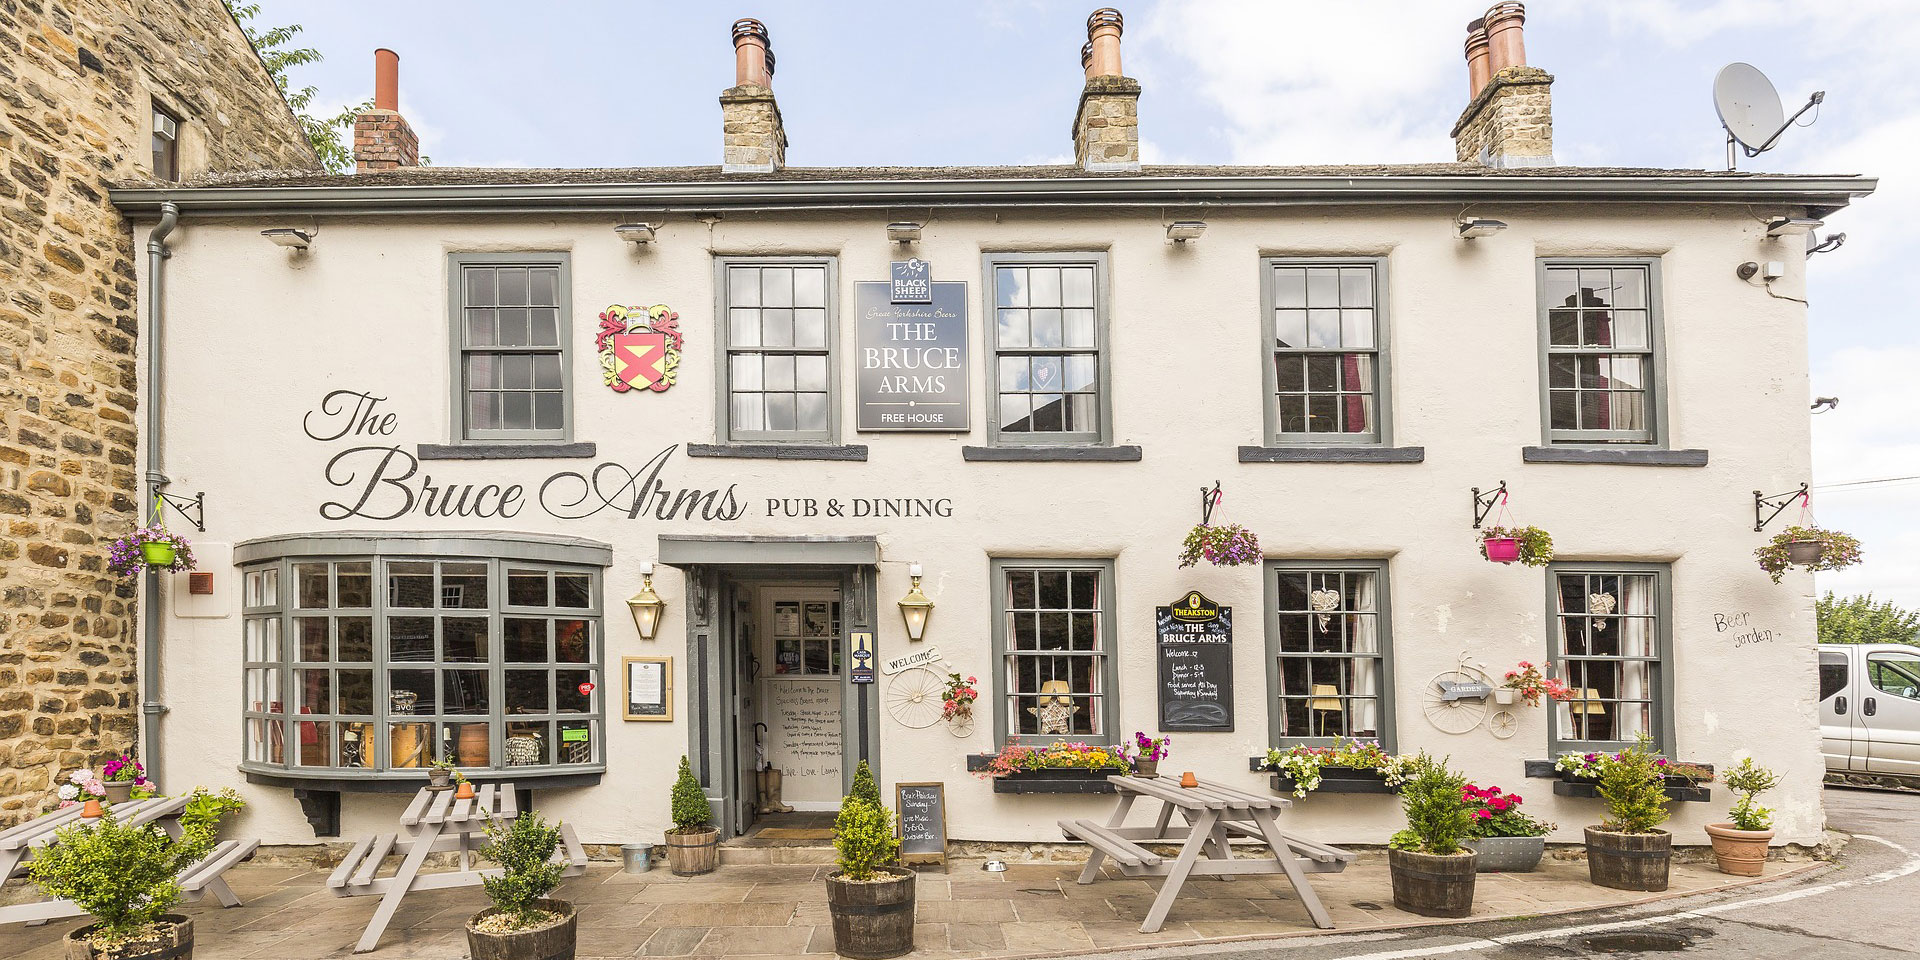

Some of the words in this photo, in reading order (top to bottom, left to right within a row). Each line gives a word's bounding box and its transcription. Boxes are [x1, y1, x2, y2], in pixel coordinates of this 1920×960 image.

[894, 279, 926, 287] BLACK
[895, 287, 927, 295] SHEEP
[866, 307, 890, 320] Great
[893, 307, 932, 320] Yorkshire
[934, 307, 958, 318] Beers
[887, 322, 938, 341] THE
[864, 348, 961, 369] BRUCE
[878, 376, 946, 394] ARMS
[303, 389, 398, 441] The
[881, 414, 906, 423] FREE
[908, 414, 944, 423] HOUSE
[319, 444, 526, 520] Bruce
[538, 444, 748, 520] Arms
[766, 498, 818, 518] PUB
[826, 498, 846, 518] &
[851, 498, 953, 518] DINING
[1174, 608, 1215, 616] THEAKSTON
[1714, 612, 1750, 632] Beer
[1184, 624, 1204, 633] THE
[1163, 634, 1195, 643] BRUCE
[1198, 634, 1227, 643] ARMS
[889, 651, 932, 670] WELCOME
[1172, 663, 1187, 671] Lunch
[1172, 671, 1189, 680] Dinner
[1206, 681, 1217, 690] Day
[1199, 689, 1217, 700] Sunday
[781, 764, 796, 777] Live
[801, 766, 816, 776] Love
